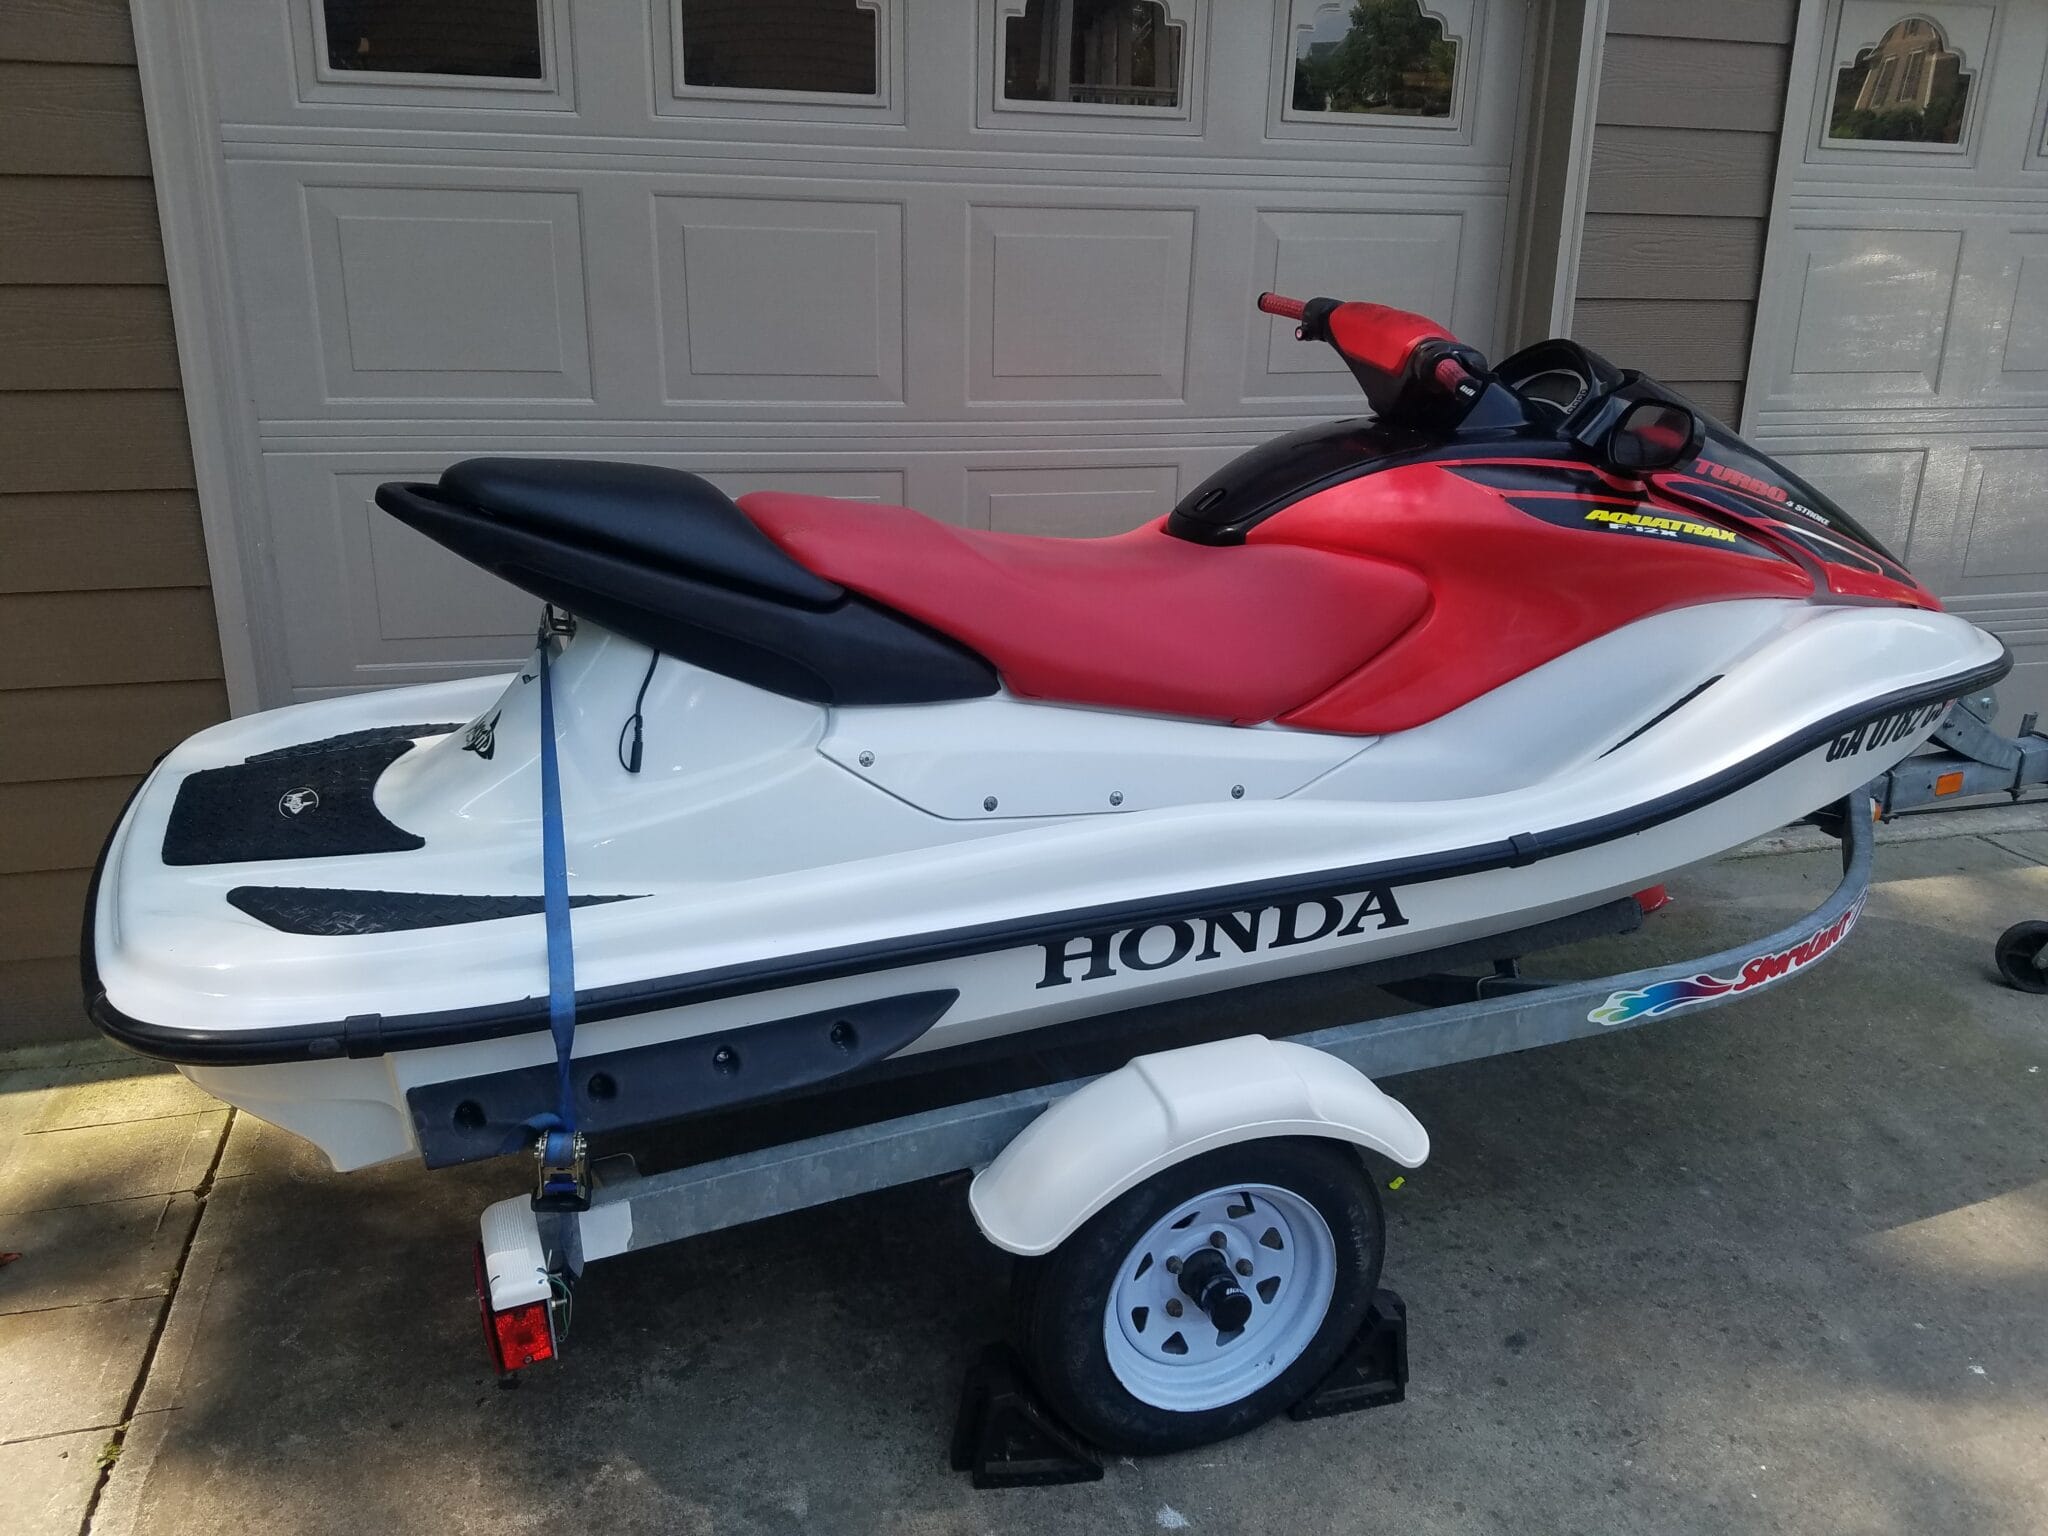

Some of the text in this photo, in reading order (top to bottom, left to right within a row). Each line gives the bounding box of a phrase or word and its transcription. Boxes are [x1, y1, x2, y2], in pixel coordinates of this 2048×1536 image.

[1694, 457, 1788, 502] TURBO
[1584, 509, 1737, 543] AQUATRAX
[1794, 504, 1830, 526] STROKE
[1035, 882, 1410, 990] HONDA
